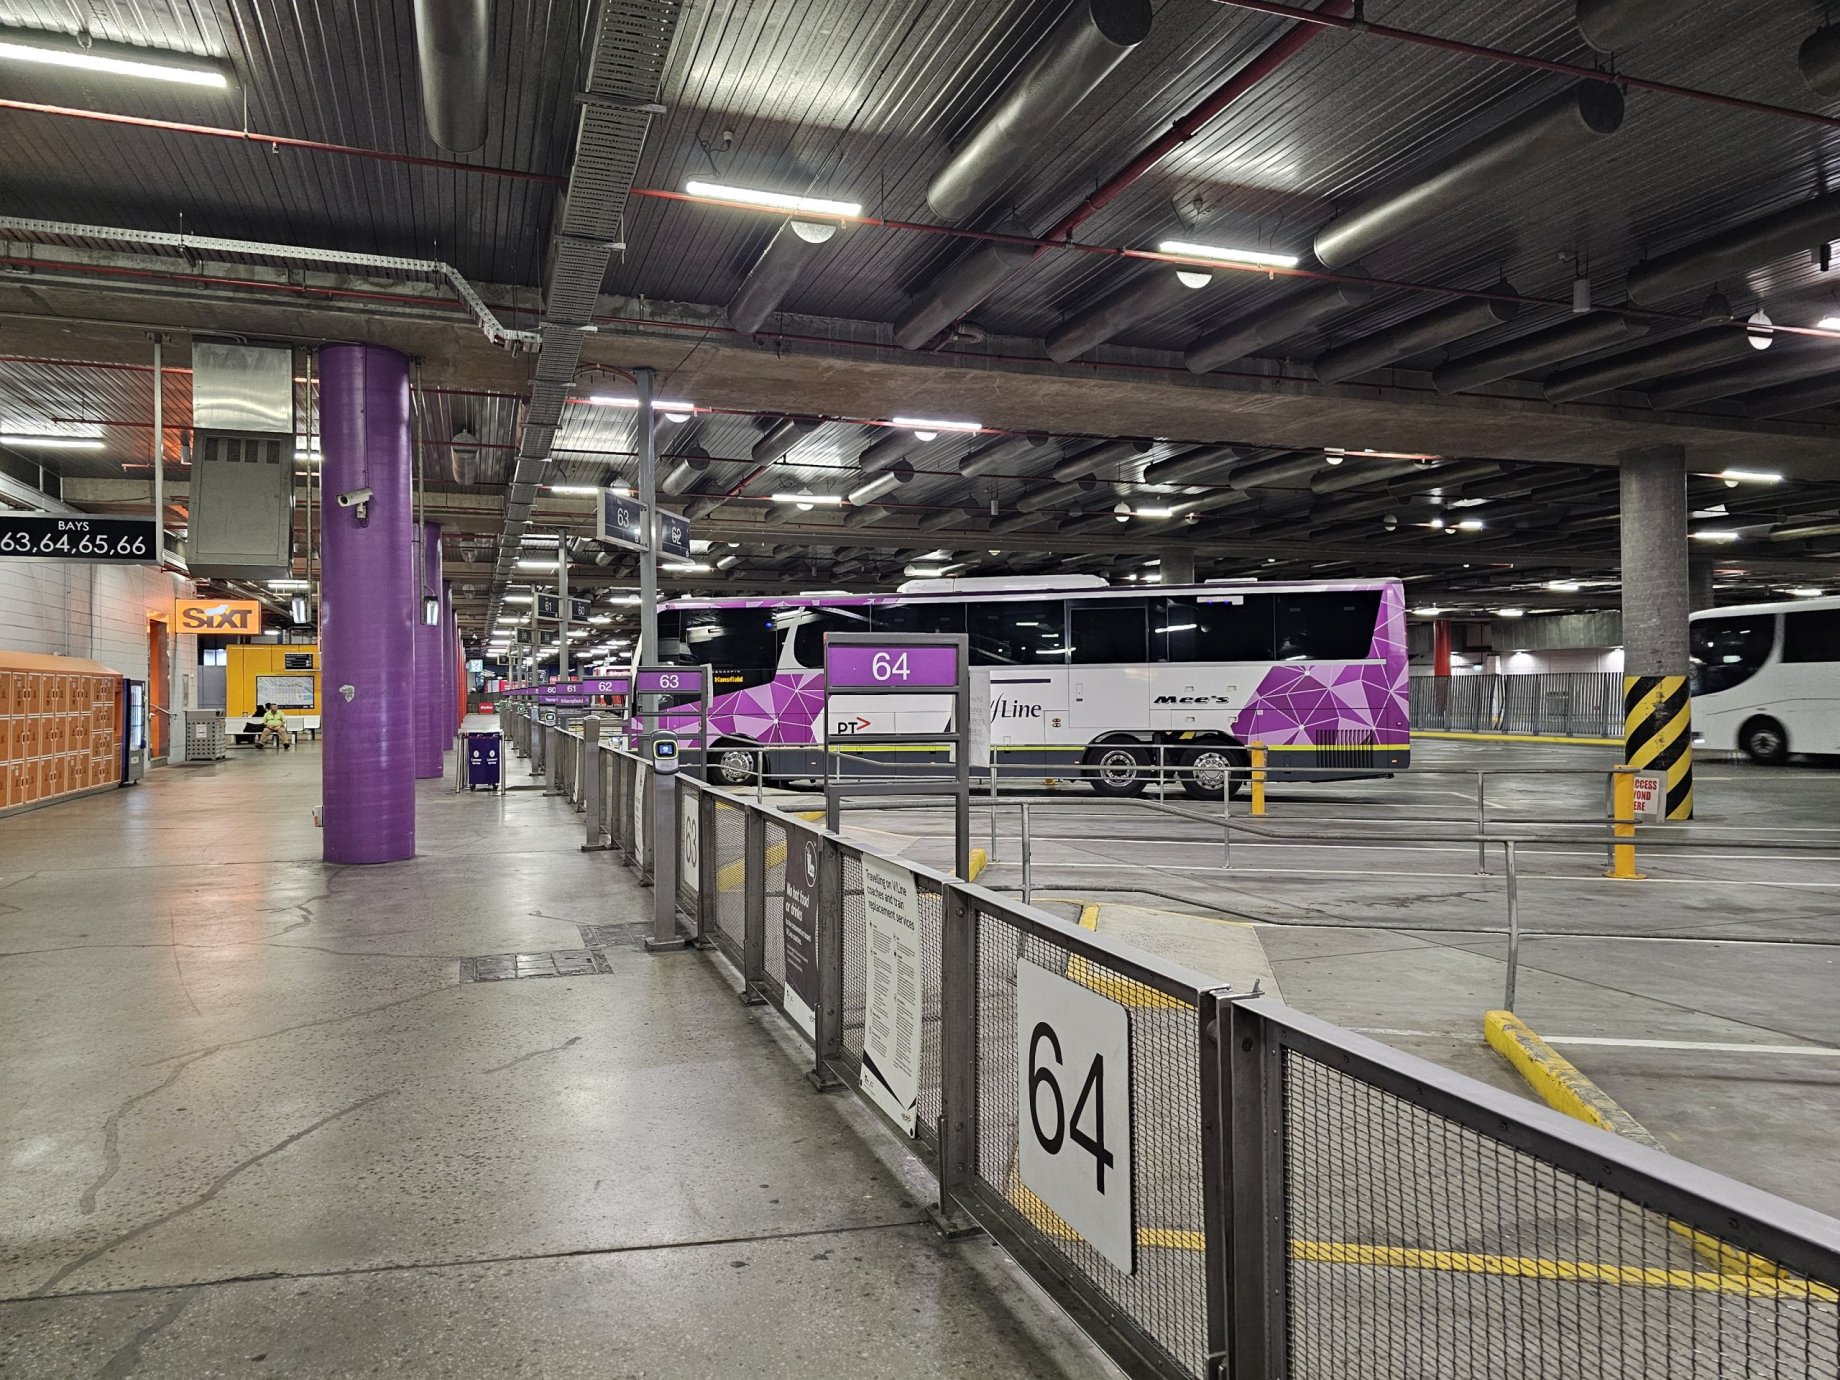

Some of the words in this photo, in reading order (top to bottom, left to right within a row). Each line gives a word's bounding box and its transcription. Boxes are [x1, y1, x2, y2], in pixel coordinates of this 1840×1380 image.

[617, 507, 629, 528] 63
[58, 520, 90, 531] BAYS
[671, 526, 682, 545] 62
[0, 531, 146, 556] 63,64,65,66
[544, 601, 552, 612] 61
[577, 605, 586, 616] 60
[872, 652, 911, 681] 64
[598, 681, 613, 692] 62
[660, 674, 679, 689] 63
[547, 686, 557, 694] 60
[566, 684, 577, 693] 61
[1153, 695, 1230, 705] Mee's
[990, 691, 1042, 724] /Line
[1634, 779, 1658, 791] CCESS
[1633, 790, 1652, 801] OND
[1633, 801, 1646, 811] ERE
[685, 815, 698, 868] 63
[866, 885, 884, 901] coaches
[884, 893, 893, 905] and
[868, 899, 896, 921] replacement
[896, 913, 915, 931] services
[1027, 1020, 1115, 1196] 64
